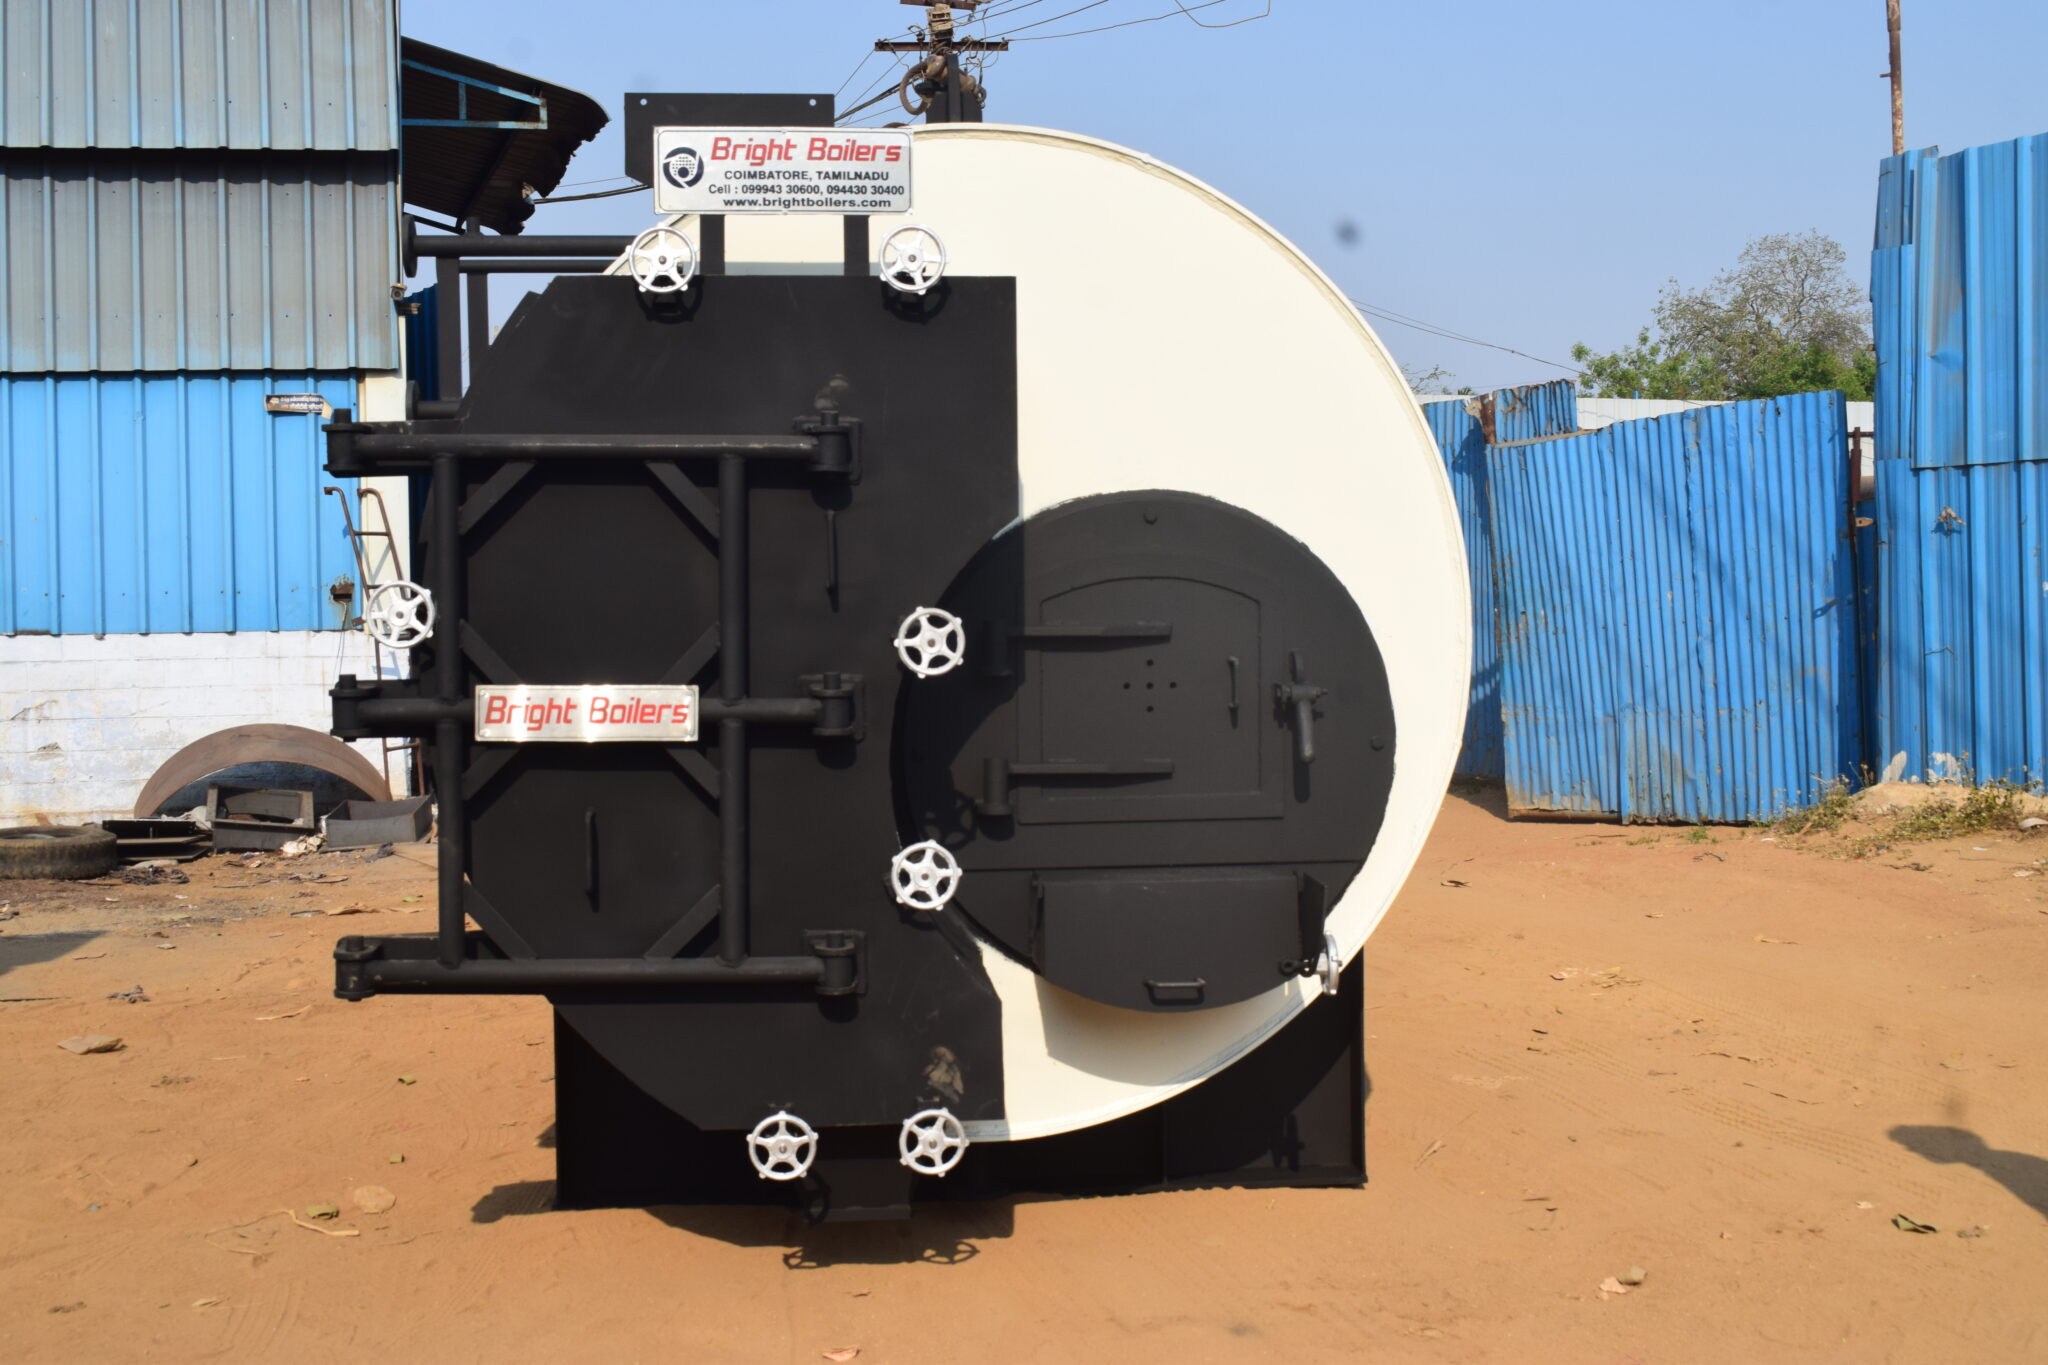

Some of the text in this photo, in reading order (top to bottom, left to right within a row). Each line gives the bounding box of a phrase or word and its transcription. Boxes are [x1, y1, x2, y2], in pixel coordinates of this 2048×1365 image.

[711, 137, 902, 166] Bright Boilers
[724, 170, 889, 182] COIMBATORE, TAMILNADU
[708, 184, 731, 194] Cell
[741, 184, 783, 194] 099943
[786, 185, 823, 196] 30600,
[826, 185, 867, 195] 094430
[870, 185, 905, 196] 30400
[723, 197, 892, 209] www.brightboilers.com
[485, 696, 689, 731] Bright Boilers
